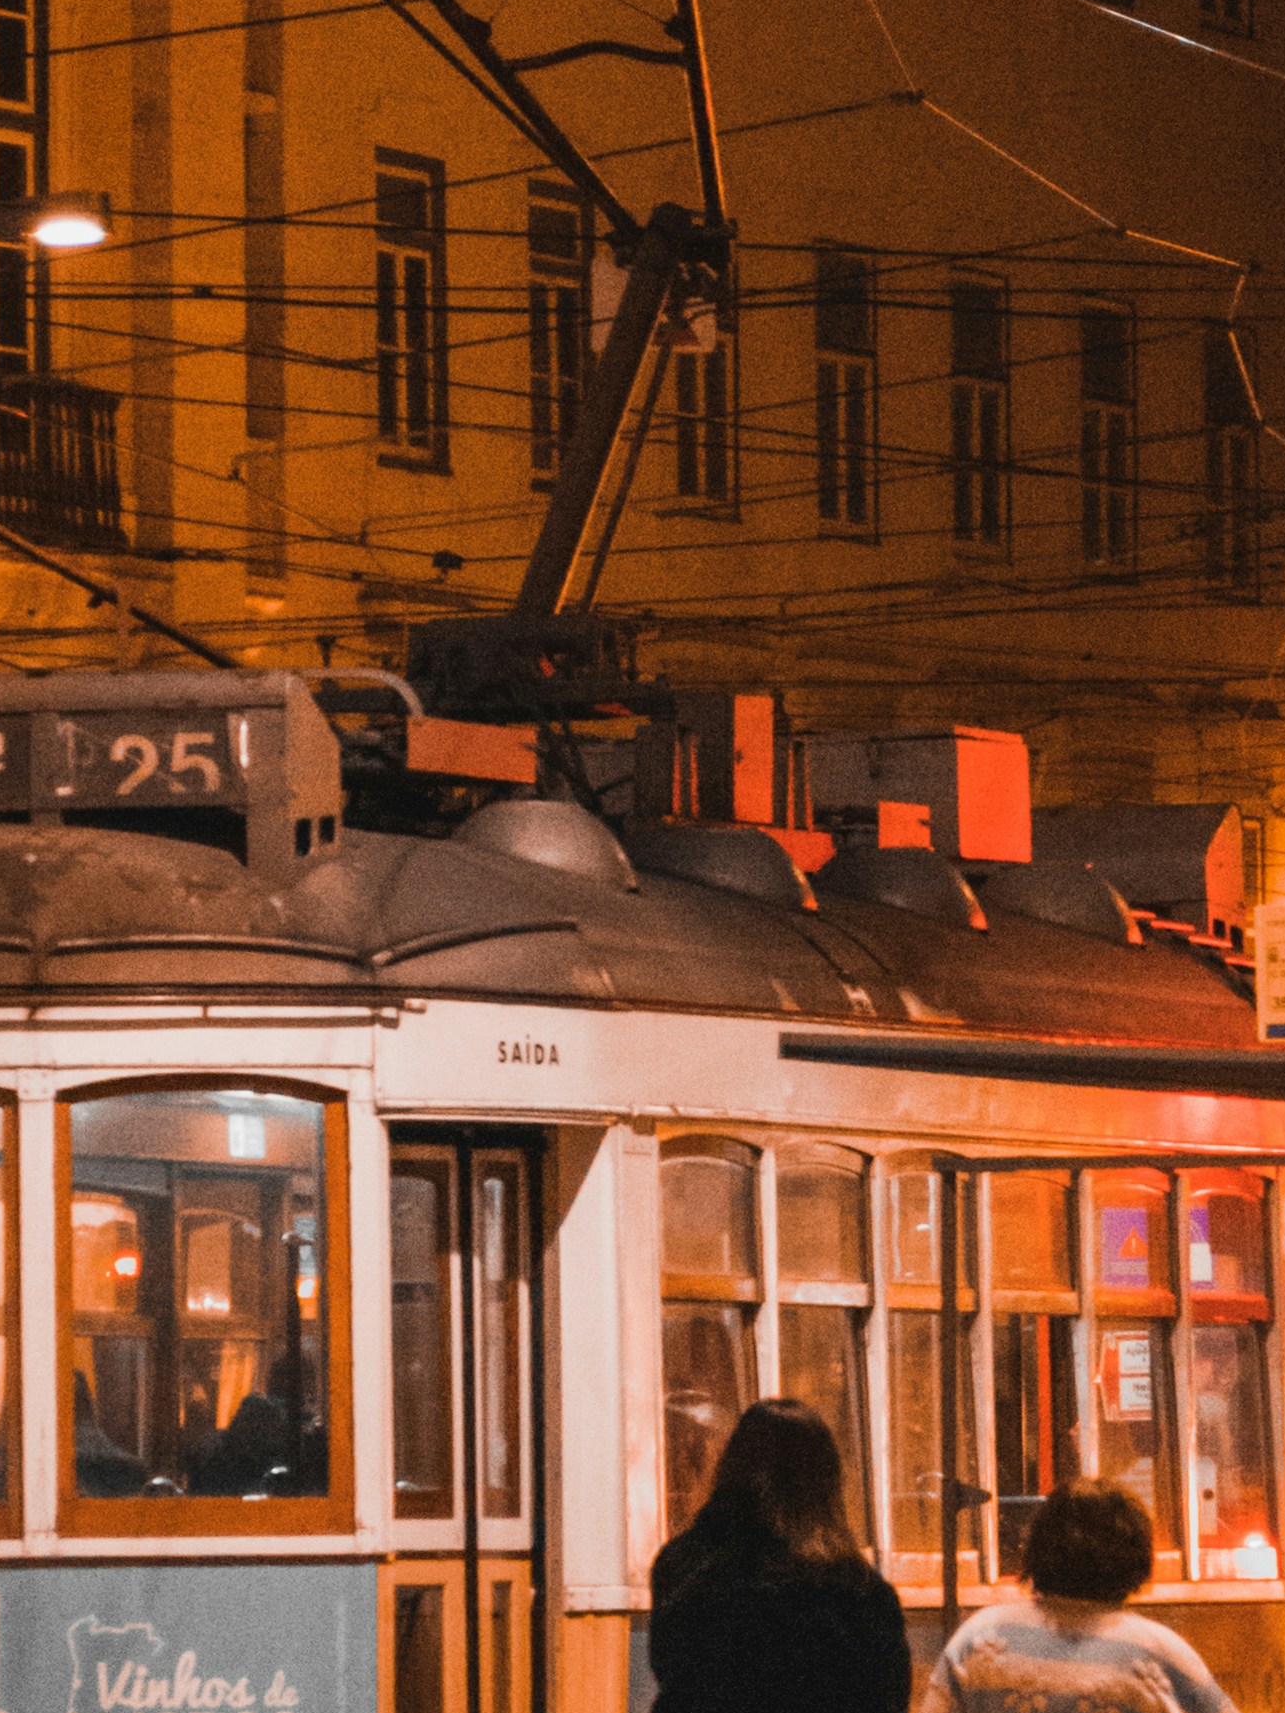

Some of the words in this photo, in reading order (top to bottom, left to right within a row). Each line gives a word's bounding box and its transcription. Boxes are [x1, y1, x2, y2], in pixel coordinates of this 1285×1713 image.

[110, 731, 221, 797] 25
[97, 1650, 257, 1710] Vinhos
[264, 1669, 300, 1708] de
